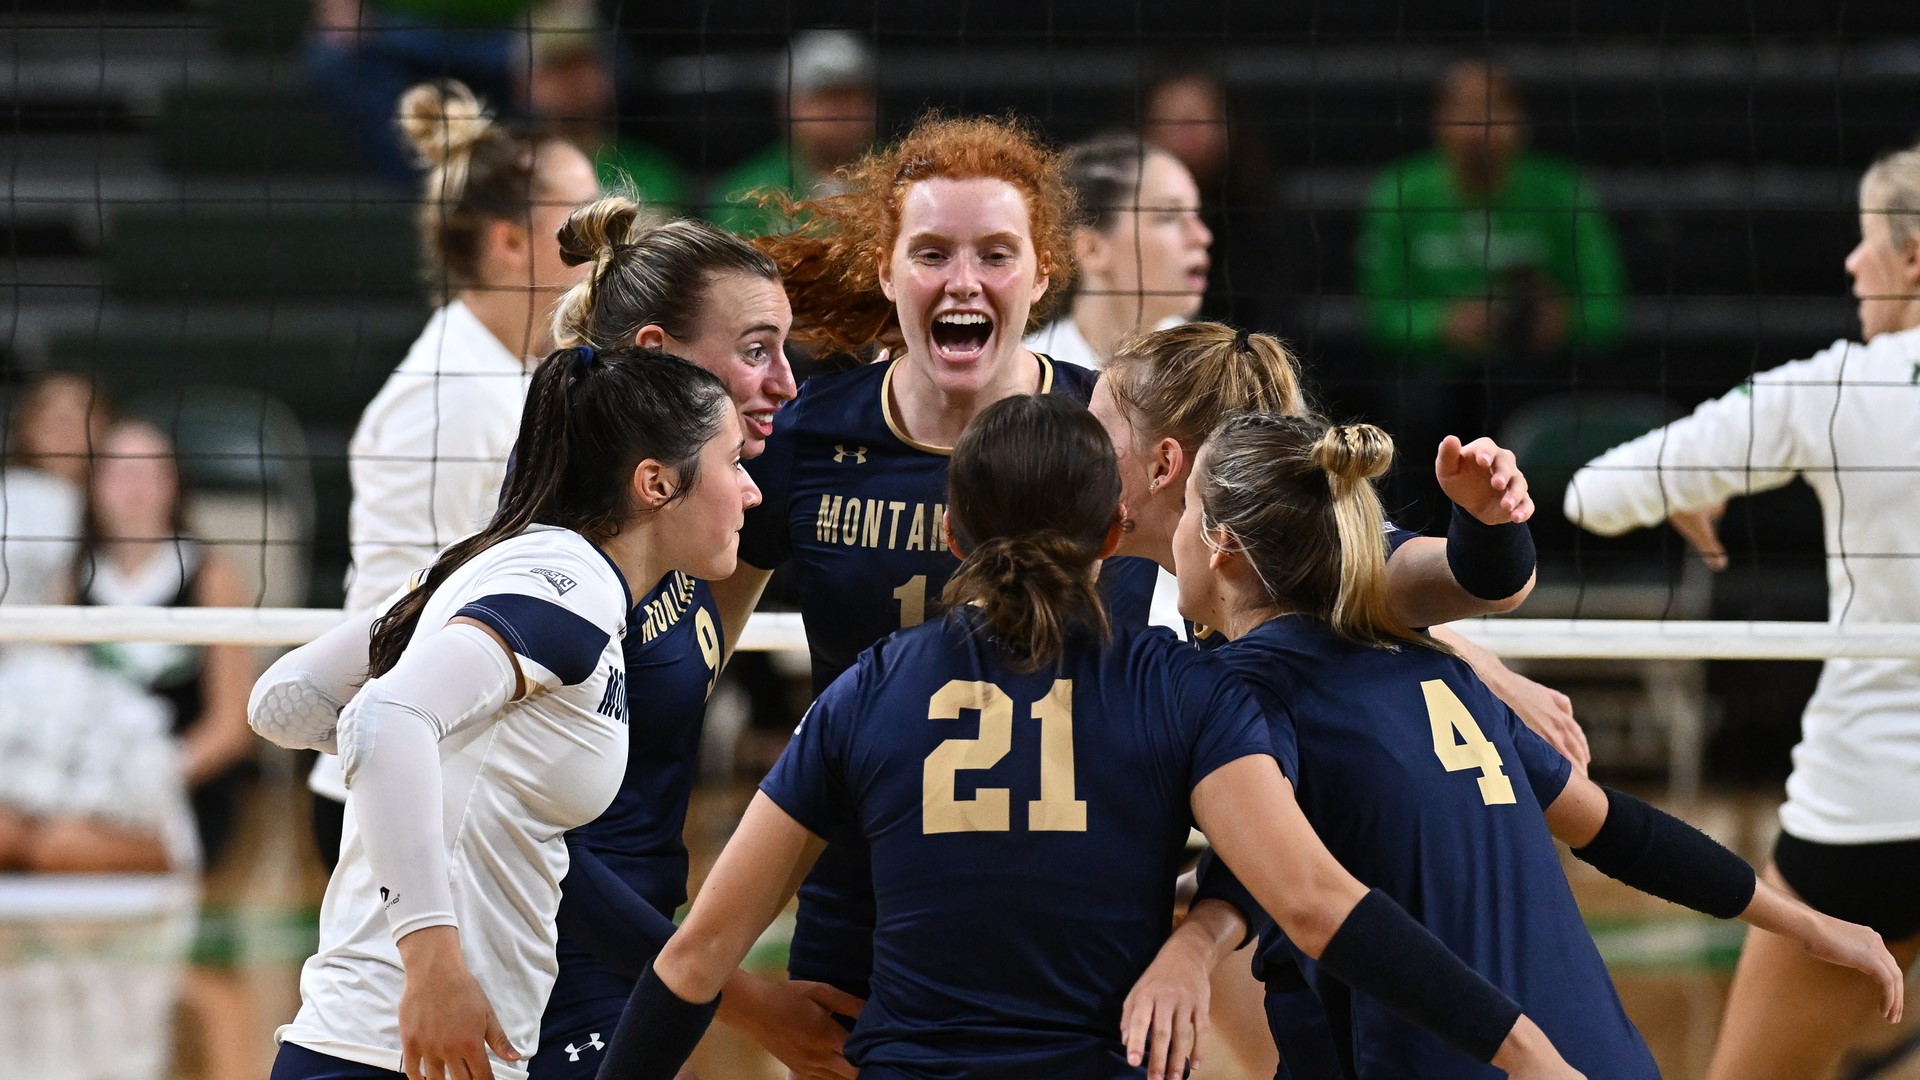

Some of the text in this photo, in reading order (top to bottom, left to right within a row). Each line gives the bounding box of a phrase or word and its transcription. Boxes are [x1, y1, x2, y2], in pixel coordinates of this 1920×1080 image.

[695, 605, 721, 703] 9
[922, 678, 1087, 835] 21
[1420, 678, 1517, 806] 4
